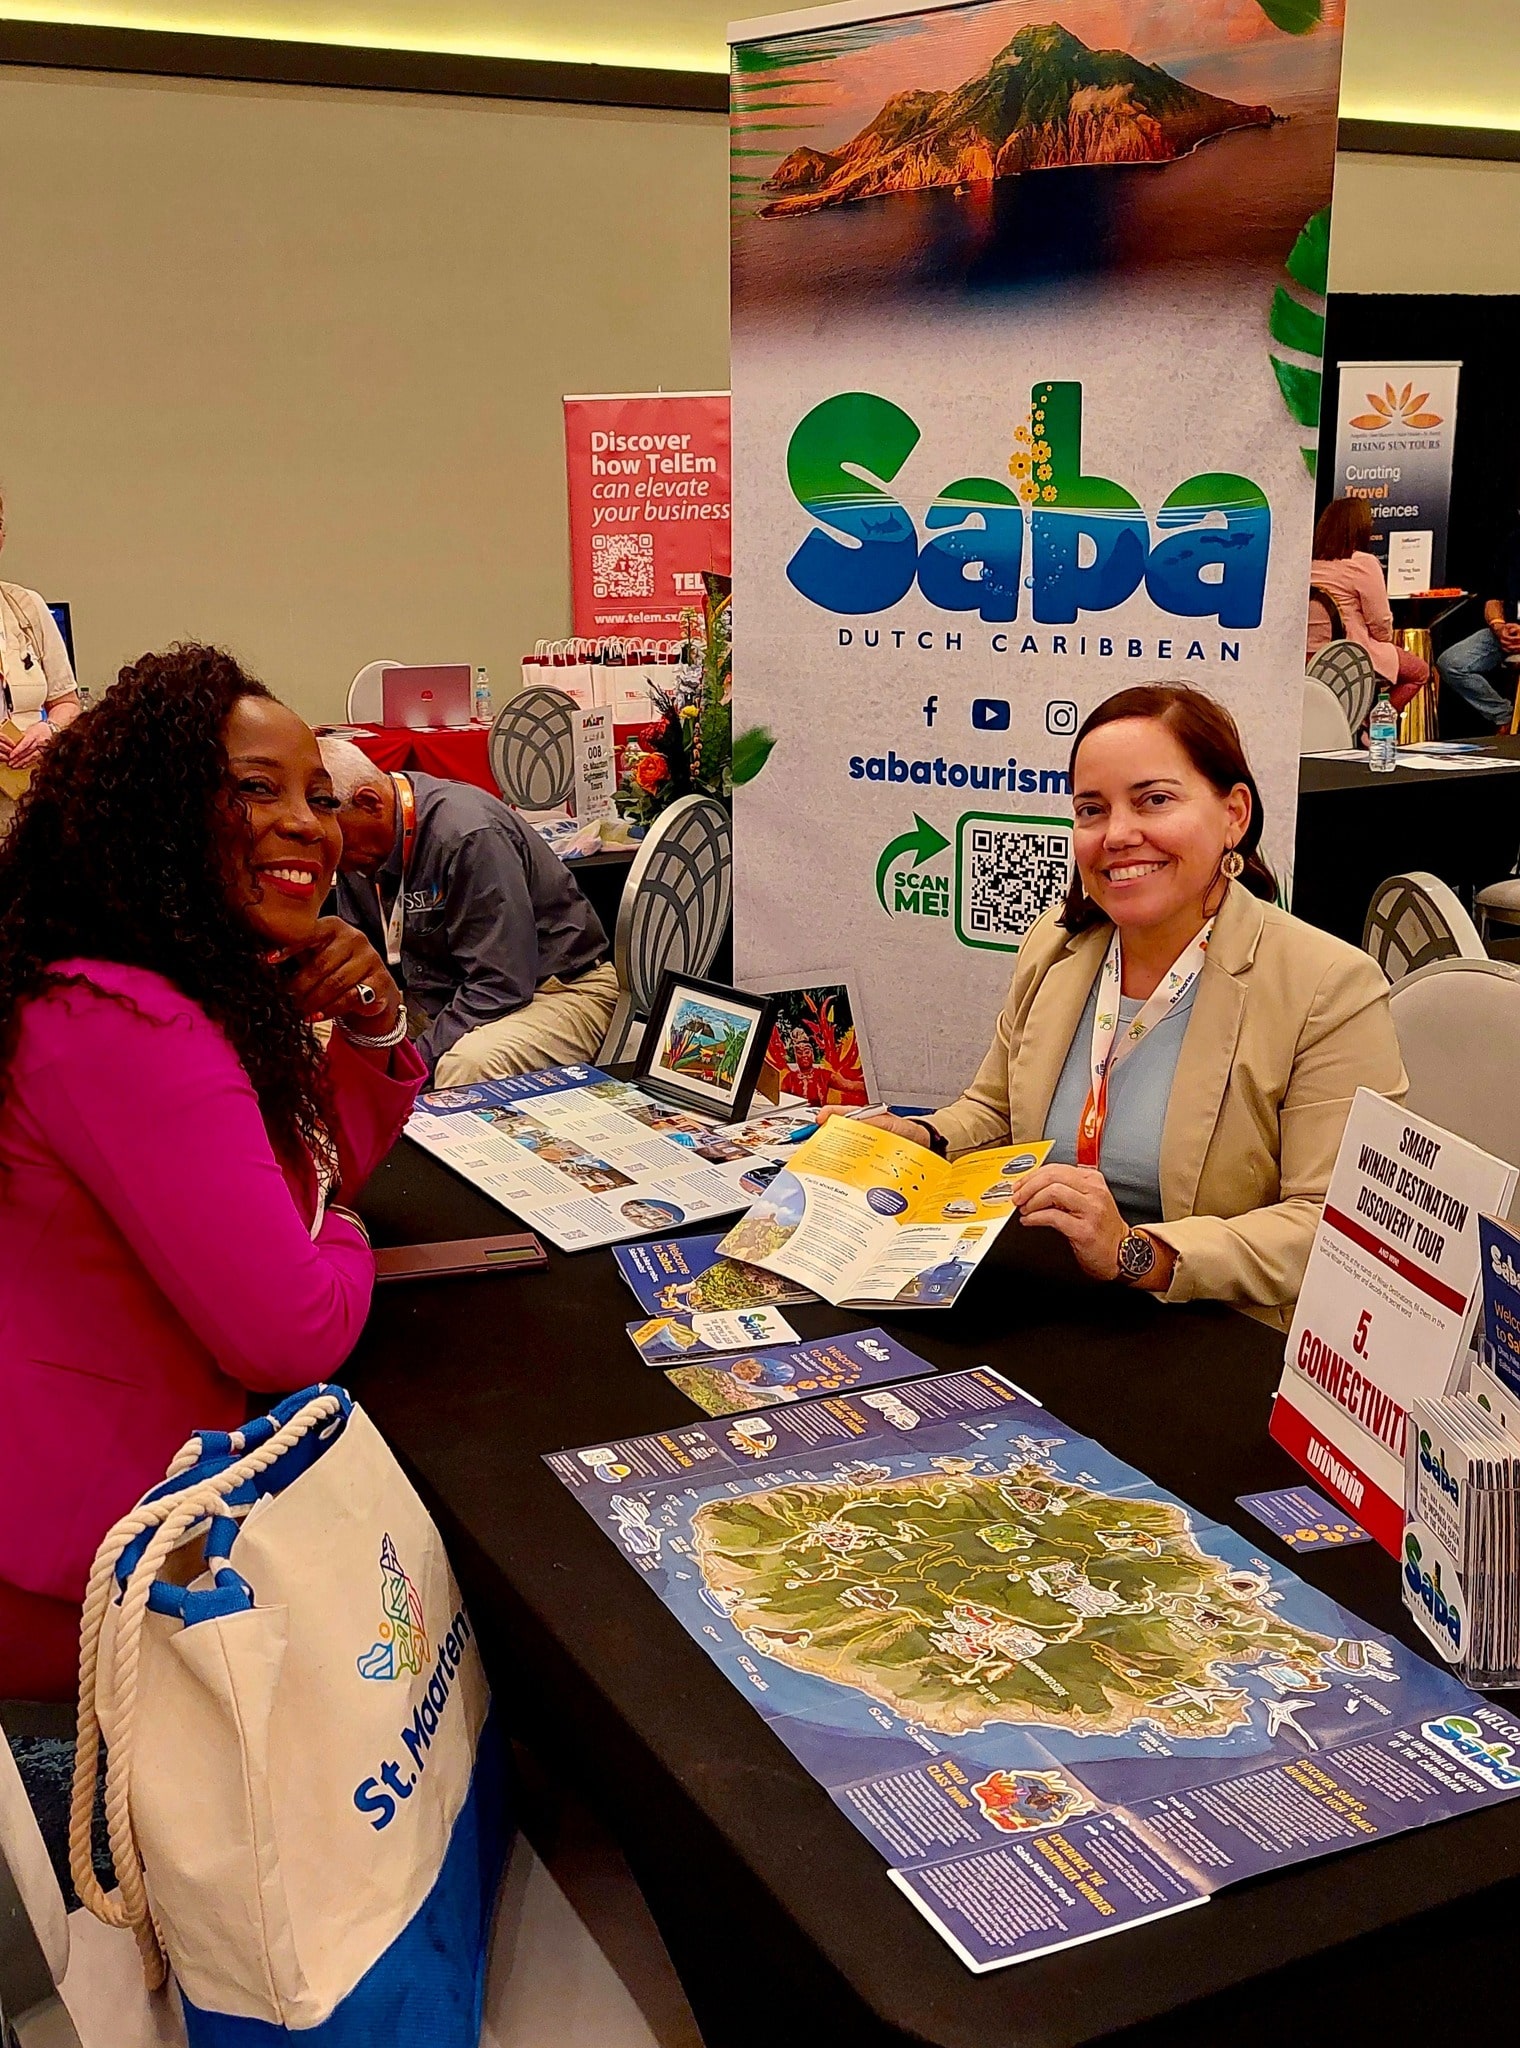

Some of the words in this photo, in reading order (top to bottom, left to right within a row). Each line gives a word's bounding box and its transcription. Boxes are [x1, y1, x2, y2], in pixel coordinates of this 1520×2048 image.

[591, 431, 691, 452] Discover
[1351, 441, 1386, 451] RISING
[1388, 440, 1407, 450] SUN
[1409, 439, 1440, 449] TOURS
[591, 457, 641, 475] how
[645, 453, 717, 474] TelEm
[1345, 466, 1400, 483] Curating
[592, 481, 630, 499] can
[634, 477, 710, 498] elevate
[787, 381, 1271, 629] Saba
[1345, 484, 1389, 499] Travel
[591, 504, 640, 528] your
[644, 501, 731, 521] business
[839, 628, 963, 652] DUTCH
[992, 634, 1241, 662] CARIBBEAN
[894, 872, 949, 892] SCAN
[894, 890, 950, 918] ME!
[1399, 1127, 1441, 1170] SMART
[1357, 1144, 1398, 1195] WINAIR
[1395, 1168, 1469, 1233] DESTINATION
[1356, 1185, 1416, 1243] DISCOVERY
[1412, 1222, 1445, 1264] TOUR
[656, 1252, 677, 1274] Saba!
[666, 1243, 690, 1274] Welcome
[738, 1313, 776, 1340] Saba
[1352, 1310, 1373, 1360] 5.
[1496, 1323, 1507, 1343] to
[825, 1345, 863, 1371] Welcome
[1420, 1430, 1459, 1508] Saba
[1404, 1532, 1461, 1650] Saba
[353, 1761, 417, 1832] St.
[400, 1611, 471, 1773] Maarten
[1473, 1708, 1520, 1741] WELCO
[1388, 1740, 1404, 1748] OF
[1400, 1747, 1421, 1760] THE
[1417, 1759, 1467, 1794] CARIBBEAN
[1394, 1730, 1414, 1741] THE
[1410, 1740, 1457, 1772] UNSPOILED
[1454, 1772, 1487, 1793] QUEEN
[1428, 1718, 1520, 1784] Saba
[926, 1765, 951, 1791] CLASS
[945, 1785, 973, 1809] DIVING
[942, 1760, 969, 1785] WORLD
[1296, 1759, 1338, 1790] DISCOVER
[1334, 1789, 1367, 1812] SABA'S
[1282, 1765, 1327, 1796] ABUNDANT
[1322, 1795, 1349, 1813] LUSH
[1344, 1811, 1378, 1834] TRAILS
[1012, 1844, 1034, 1865] Saba
[1030, 1861, 1057, 1889] Marine
[1054, 1886, 1076, 1907] Park
[1032, 1838, 1081, 1882] UNDERWATER
[1075, 1880, 1117, 1916] WONDERS
[1047, 1833, 1093, 1874] EXPERIENCE
[1086, 1869, 1109, 1887] THE
